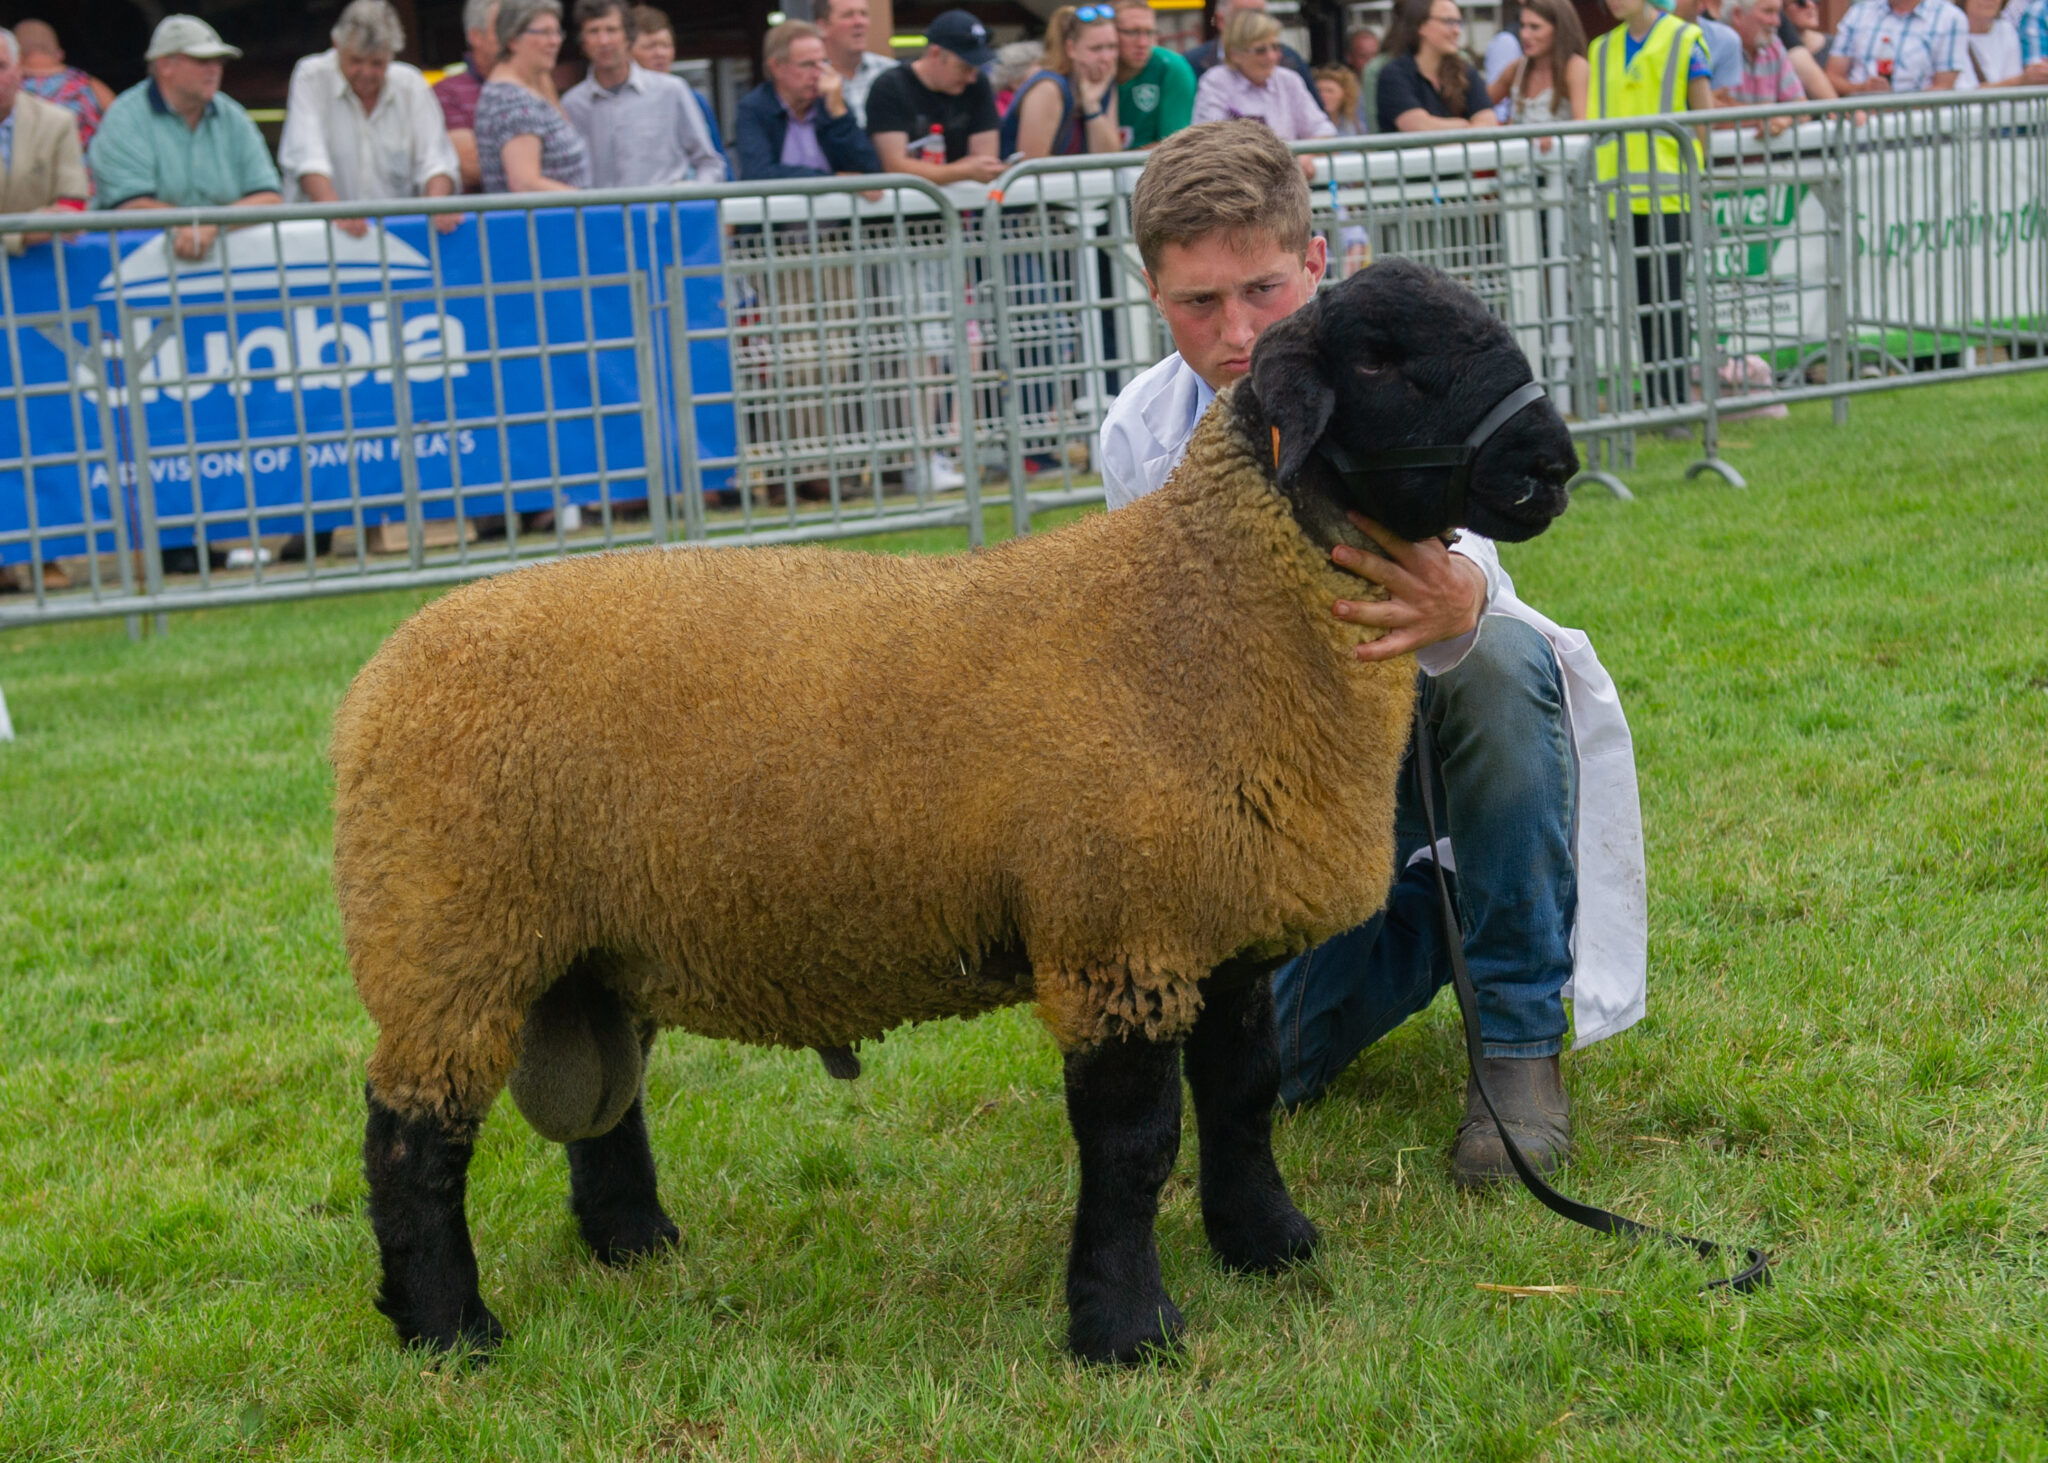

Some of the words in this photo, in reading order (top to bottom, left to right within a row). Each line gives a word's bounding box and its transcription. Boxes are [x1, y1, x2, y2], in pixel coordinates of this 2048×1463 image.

[75, 300, 470, 408] dunbia
[118, 451, 247, 487] DVISON
[253, 446, 292, 474] OF
